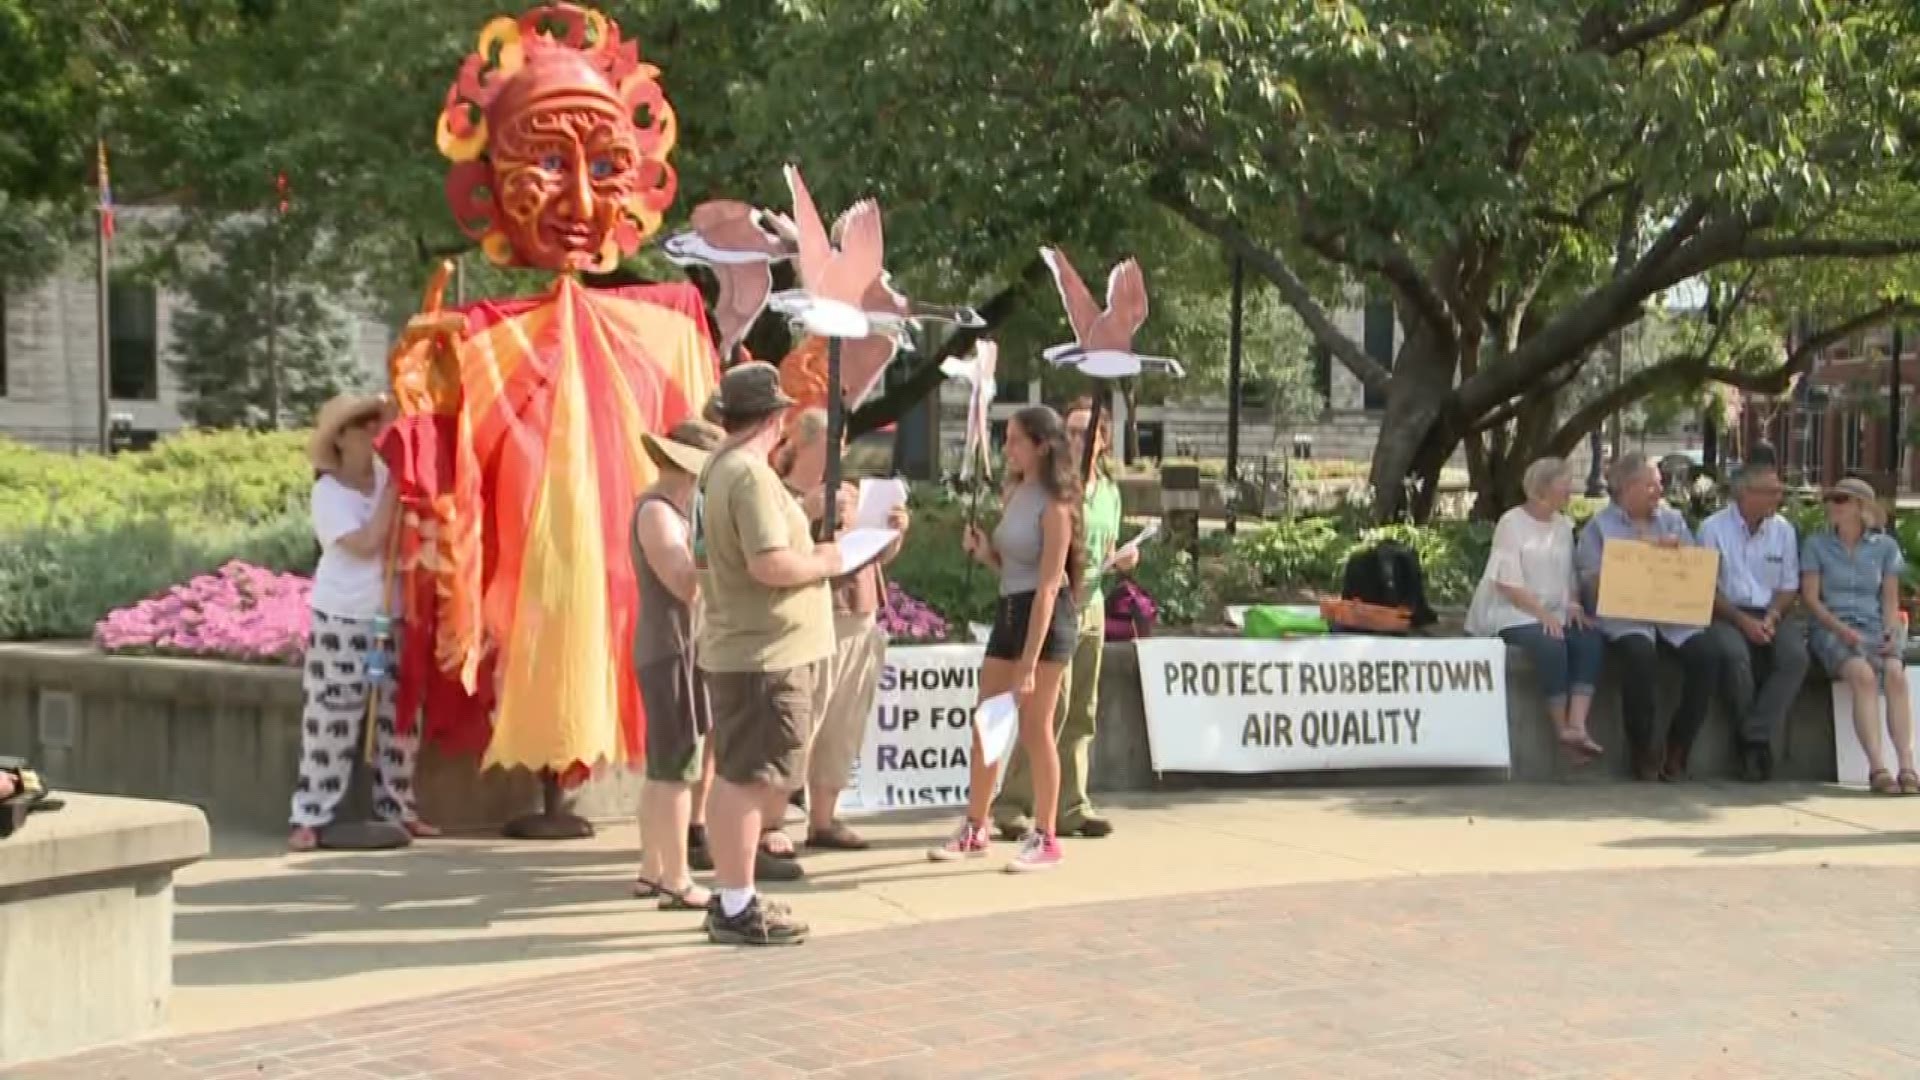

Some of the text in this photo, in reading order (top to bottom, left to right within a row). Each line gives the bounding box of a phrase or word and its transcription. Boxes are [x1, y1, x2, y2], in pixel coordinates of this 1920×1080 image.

[878, 666, 981, 691] SHOWI
[1164, 660, 1494, 696] PROTECT RUBBERTOWN
[878, 705, 920, 731] UP
[1242, 709, 1421, 749] AIR QUALITY
[877, 745, 967, 771] RACIA
[879, 785, 970, 806] JUSTI
